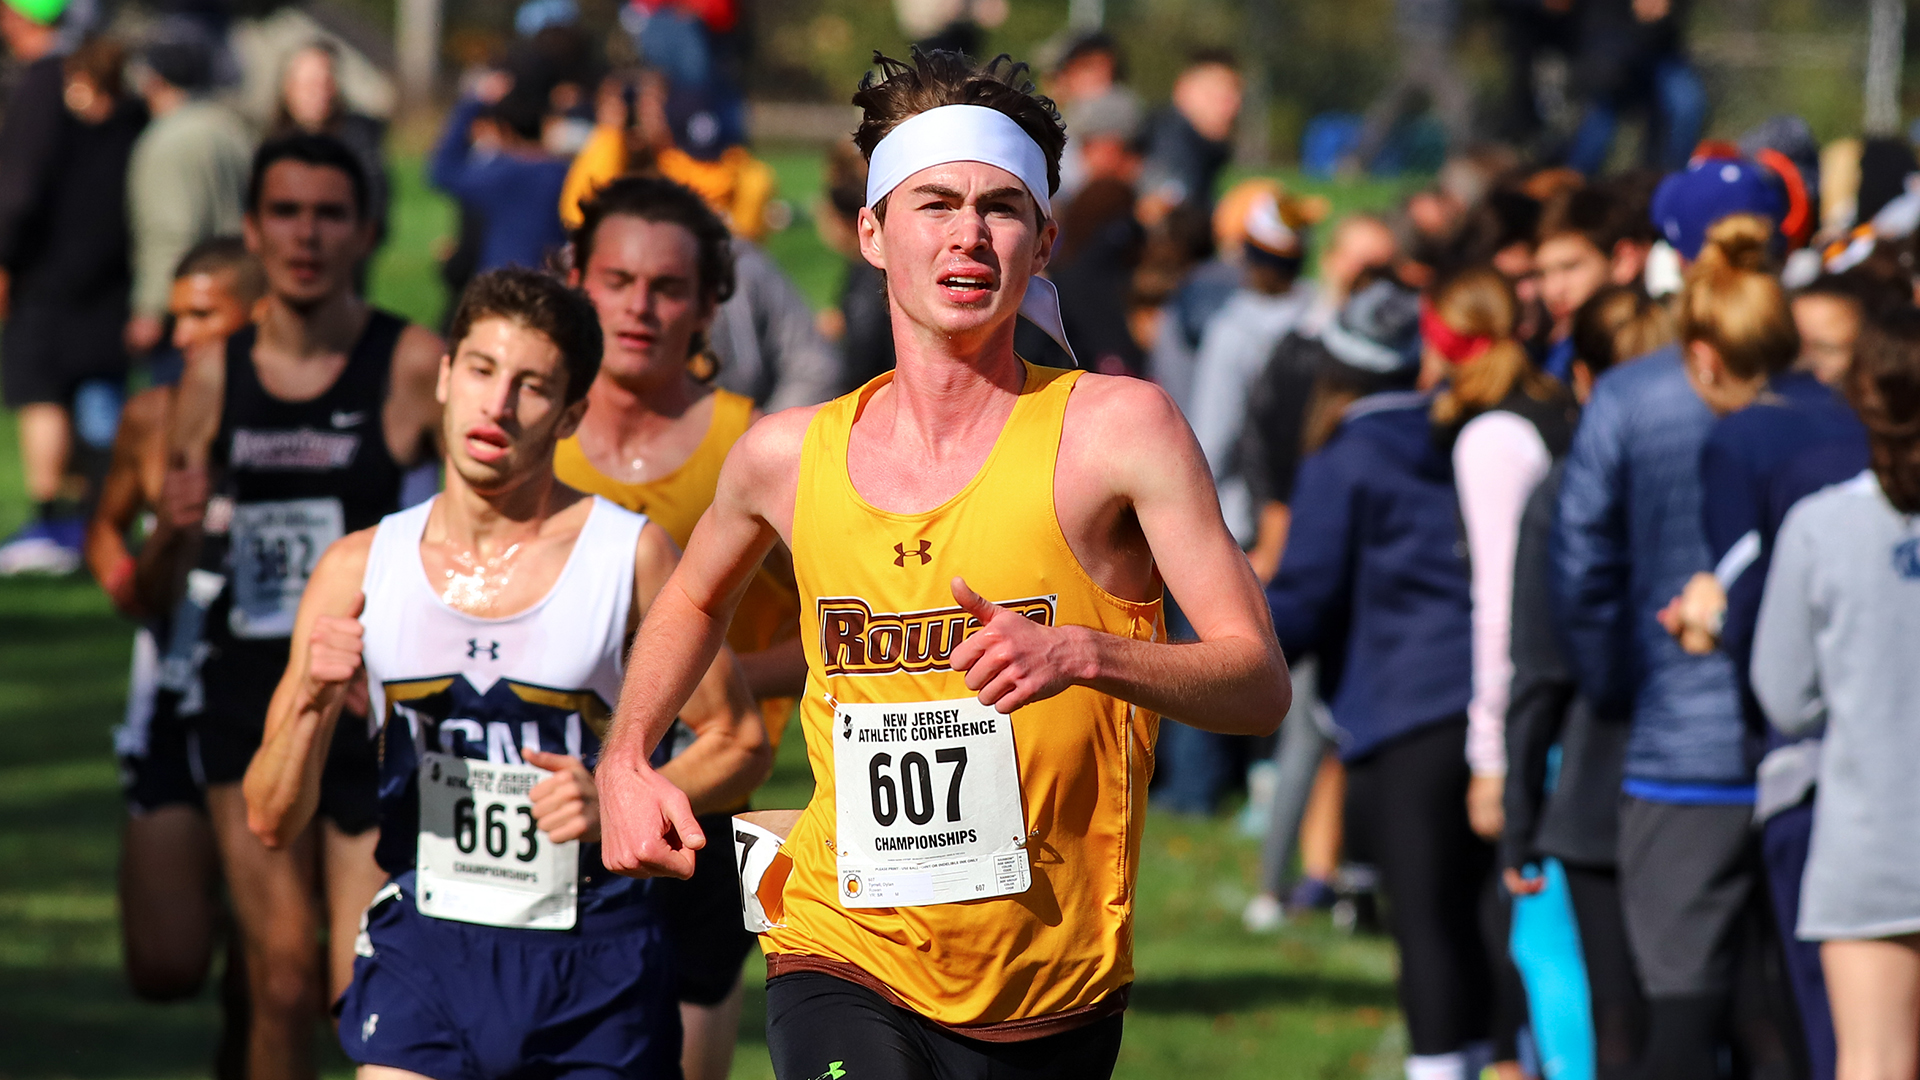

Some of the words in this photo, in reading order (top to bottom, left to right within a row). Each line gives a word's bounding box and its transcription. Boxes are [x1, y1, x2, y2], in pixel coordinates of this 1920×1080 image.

[817, 597, 1057, 677] Row
[883, 713, 907, 727] NEW
[912, 709, 959, 726] JERSEY
[859, 728, 907, 742] ATHLETIC
[911, 719, 996, 742] CONFERENCE
[869, 746, 967, 826] 607
[455, 796, 538, 862] 663
[875, 829, 977, 851] CHAMPIONSHIPS
[453, 861, 539, 883] CHAMPIONSHIPS
[975, 884, 985, 892] 607
